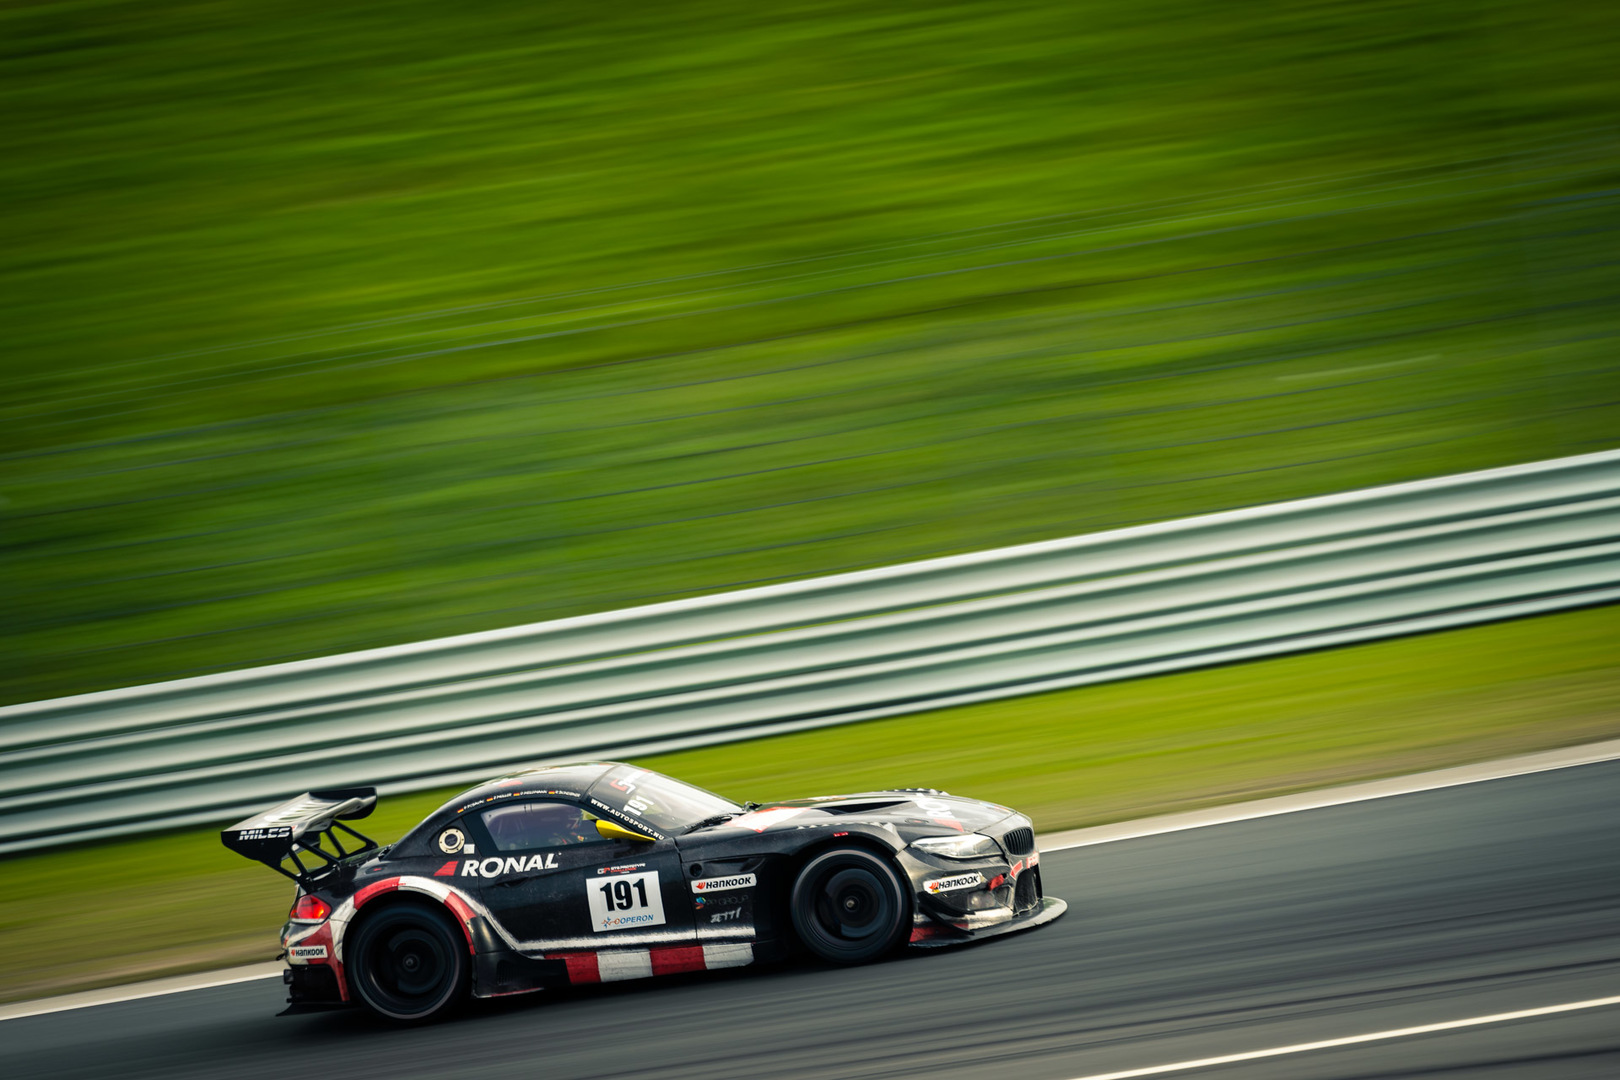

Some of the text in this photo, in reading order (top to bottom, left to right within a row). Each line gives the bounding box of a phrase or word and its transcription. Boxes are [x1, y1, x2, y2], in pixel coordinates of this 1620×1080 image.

[623, 795, 655, 816] 191
[590, 798, 665, 840] WWW.AUTOSPORT.NU
[239, 827, 291, 840] MILES
[461, 853, 559, 878] RONAL
[600, 878, 648, 912] 191
